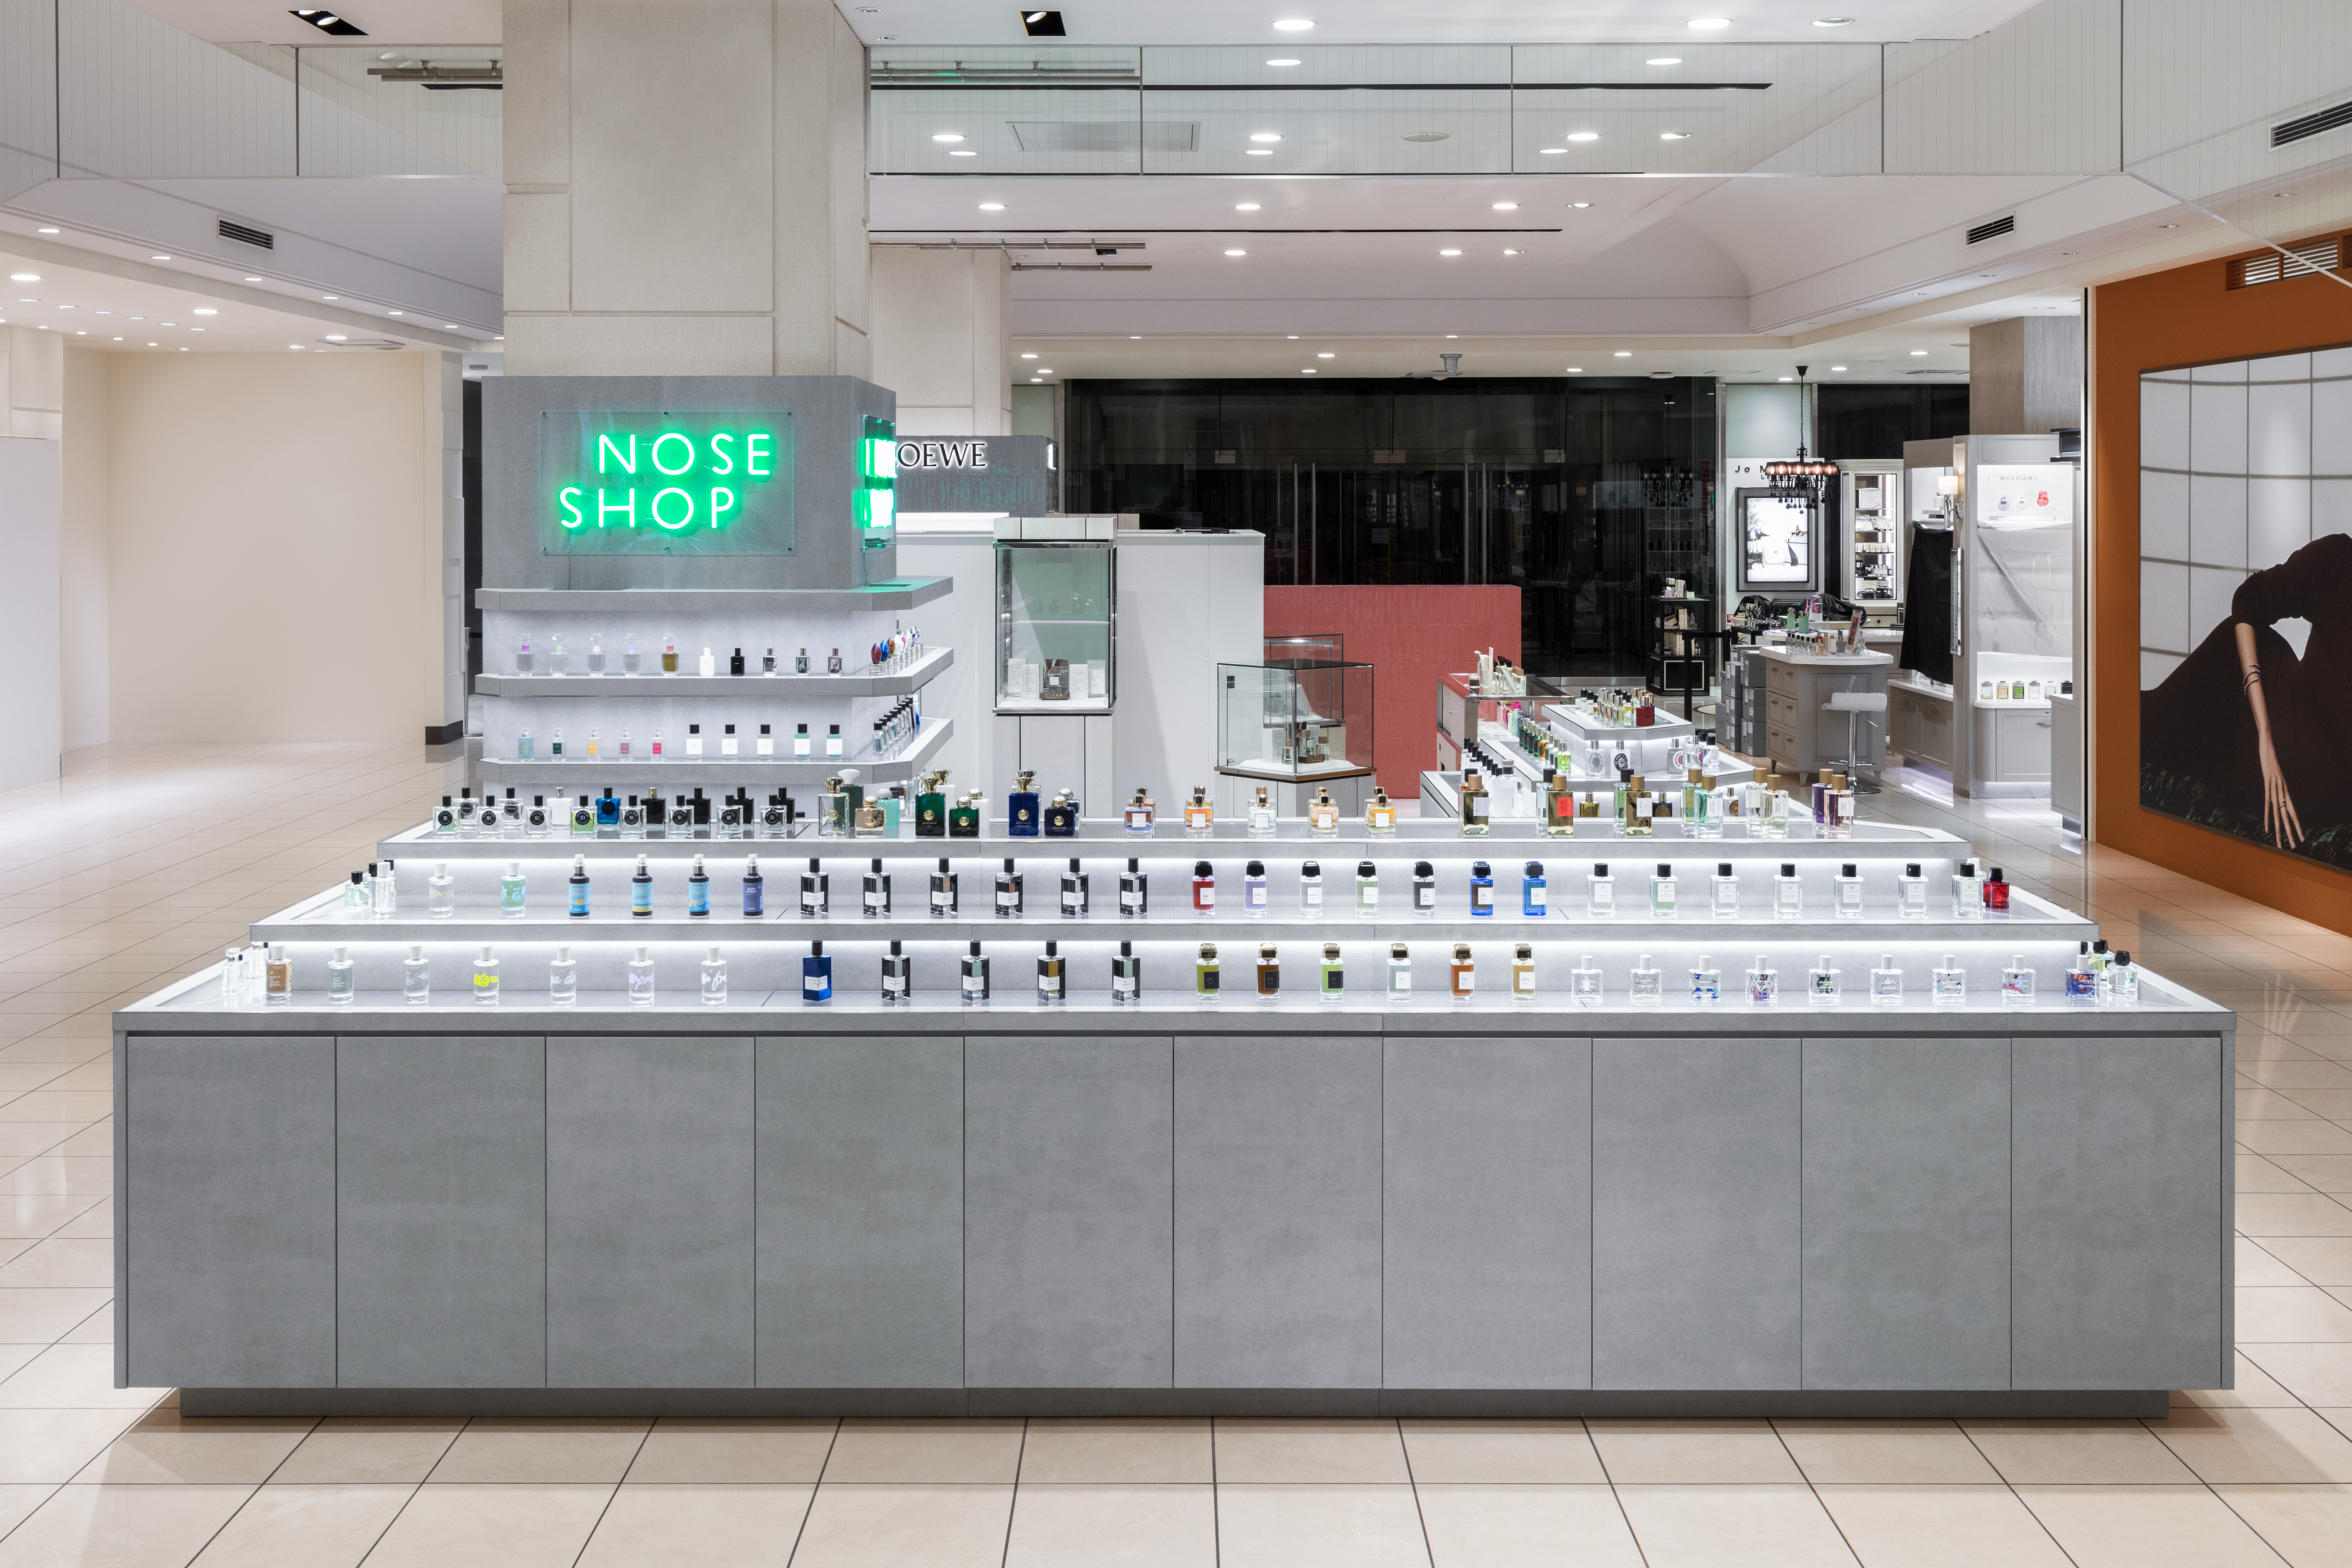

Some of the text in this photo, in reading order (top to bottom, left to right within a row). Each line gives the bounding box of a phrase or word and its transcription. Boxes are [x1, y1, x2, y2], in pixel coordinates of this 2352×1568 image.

[598, 433, 770, 475] NOSE
[897, 443, 986, 467] OEWE
[560, 486, 735, 529] SHOP
